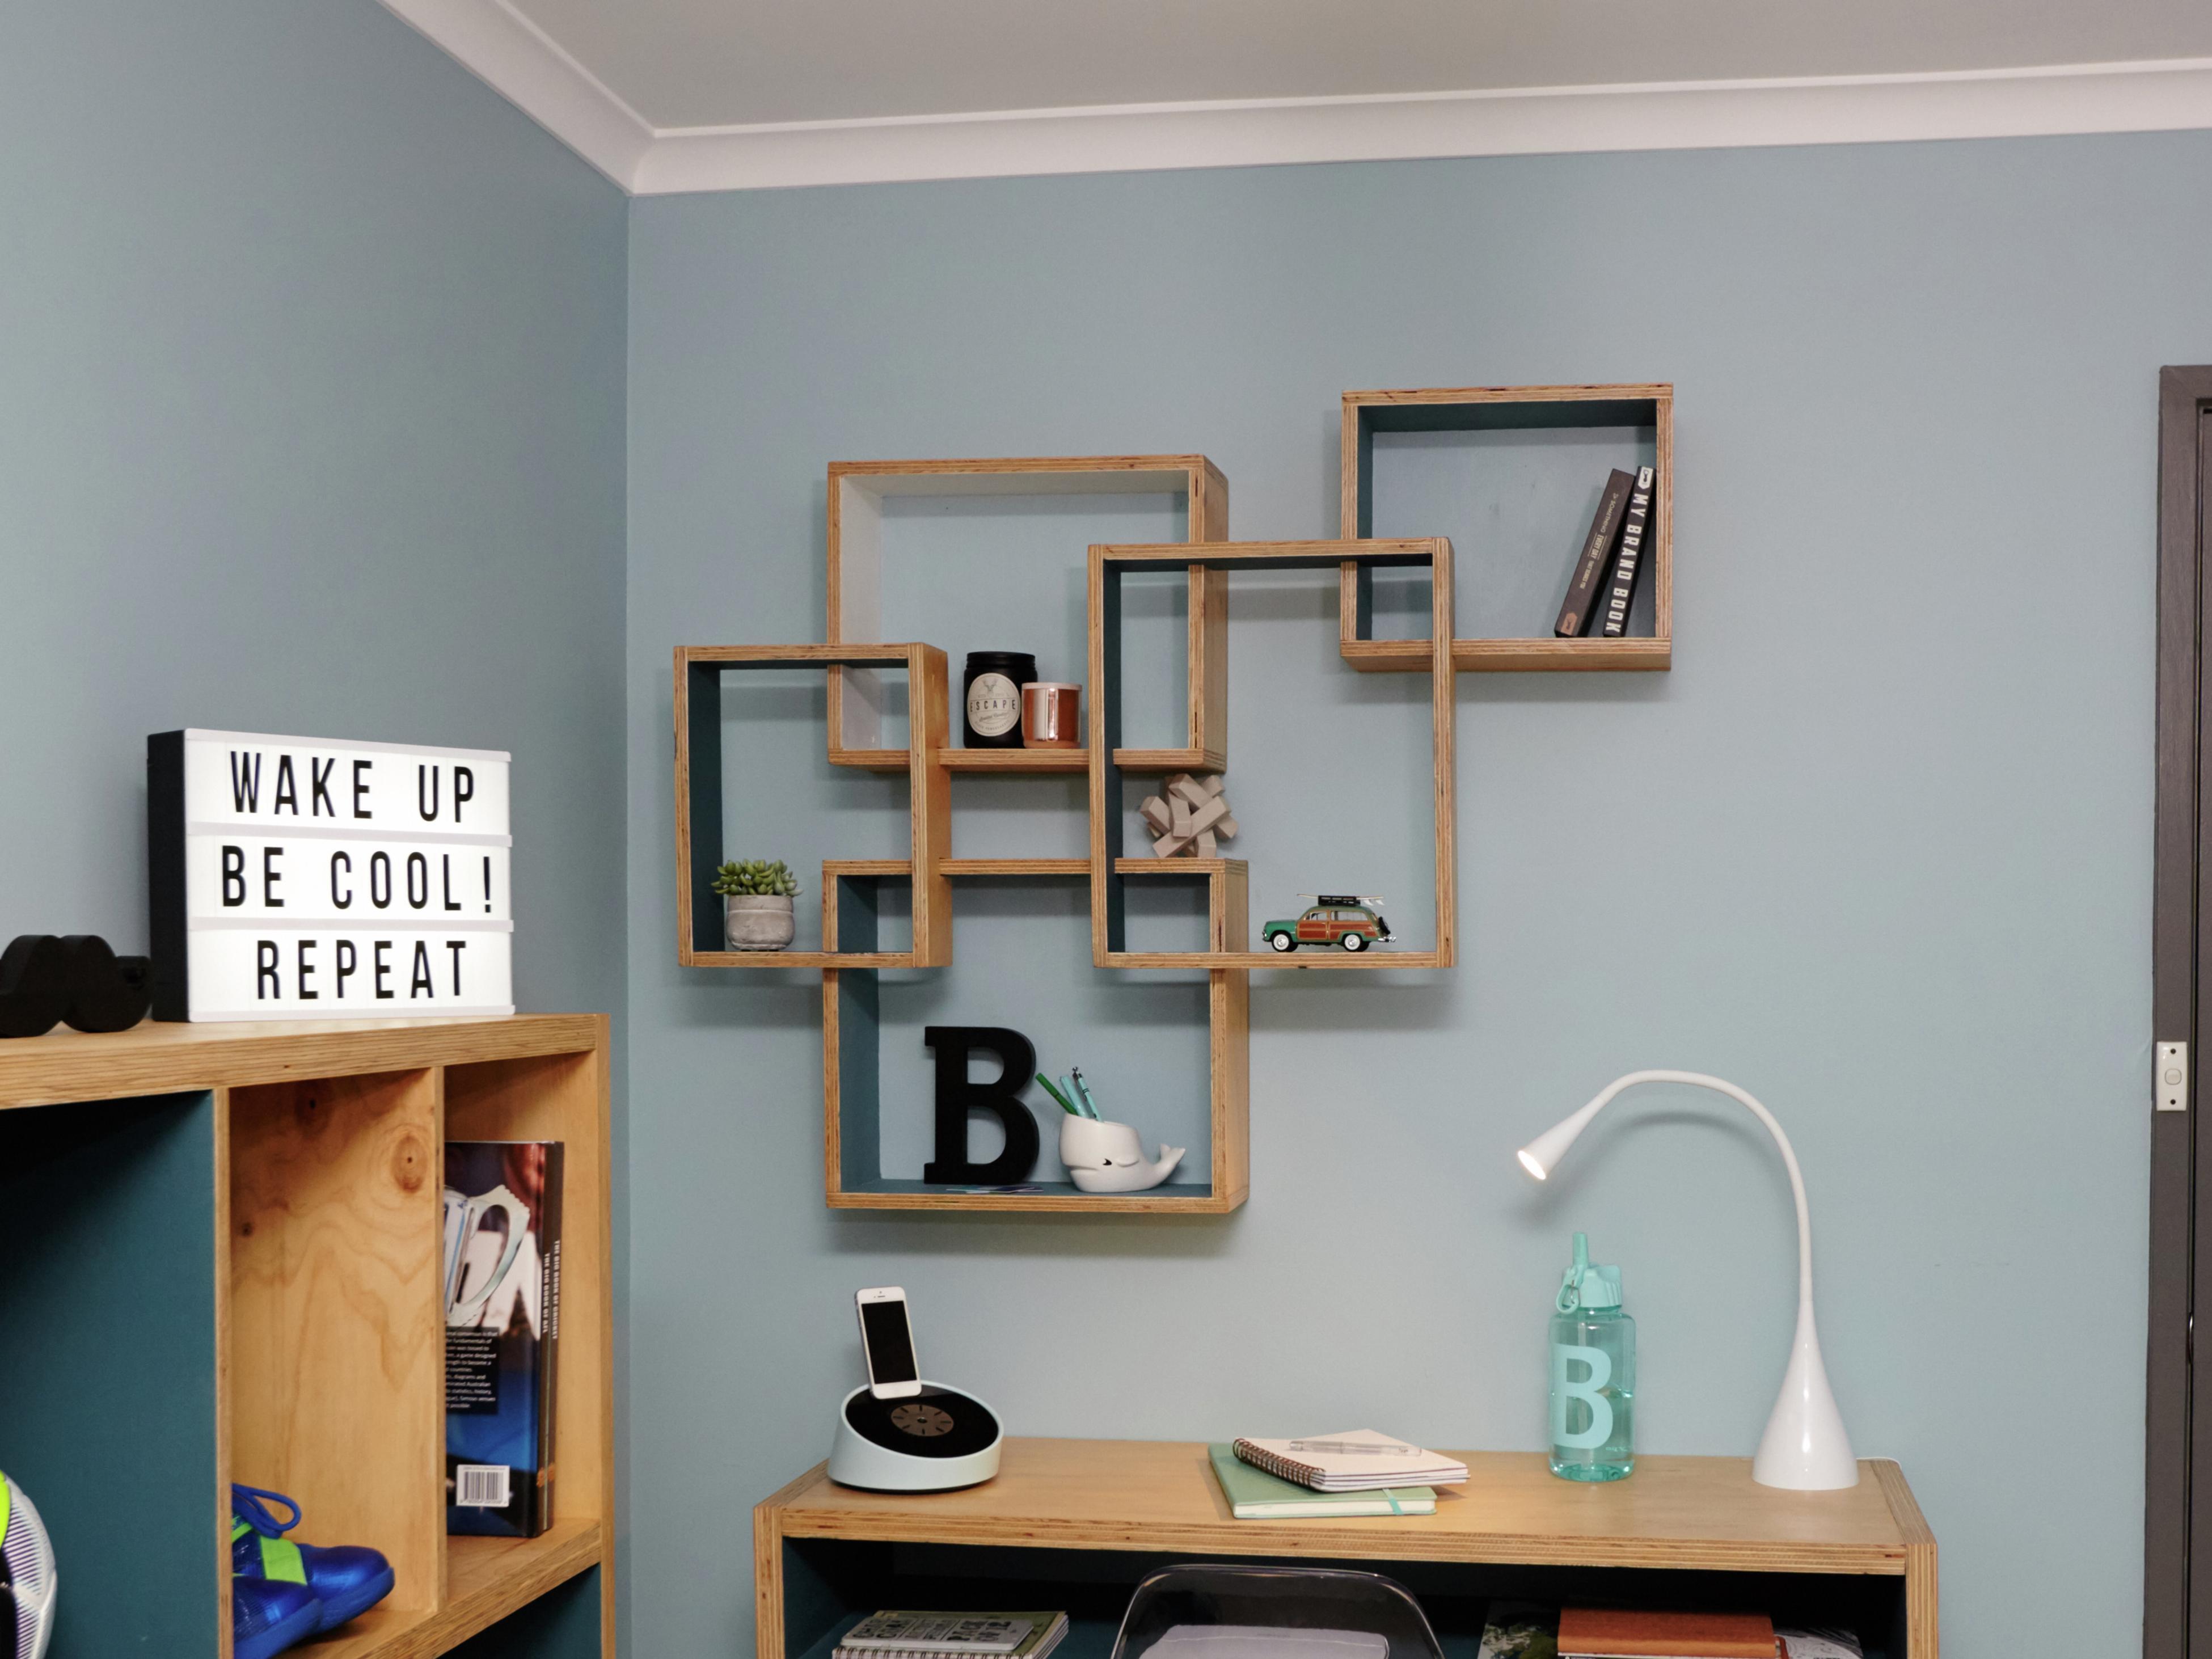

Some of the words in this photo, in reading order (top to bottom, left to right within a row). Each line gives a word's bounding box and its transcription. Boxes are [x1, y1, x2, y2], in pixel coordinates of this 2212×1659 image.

[1631, 493, 1649, 517] MY
[1617, 524, 1642, 580] BRAND
[1606, 587, 1628, 633] BOOK
[970, 699, 1016, 712] ESCAPE
[230, 751, 373, 819] WAKE
[419, 764, 474, 823] UP
[222, 845, 285, 907] BE
[331, 850, 492, 913] COOL!
[257, 939, 466, 1000] REPEAT
[924, 1026, 1040, 1185] B
[543, 1308, 548, 1318] OF
[552, 1295, 559, 1305] OF
[1552, 1343, 1613, 1449] B
